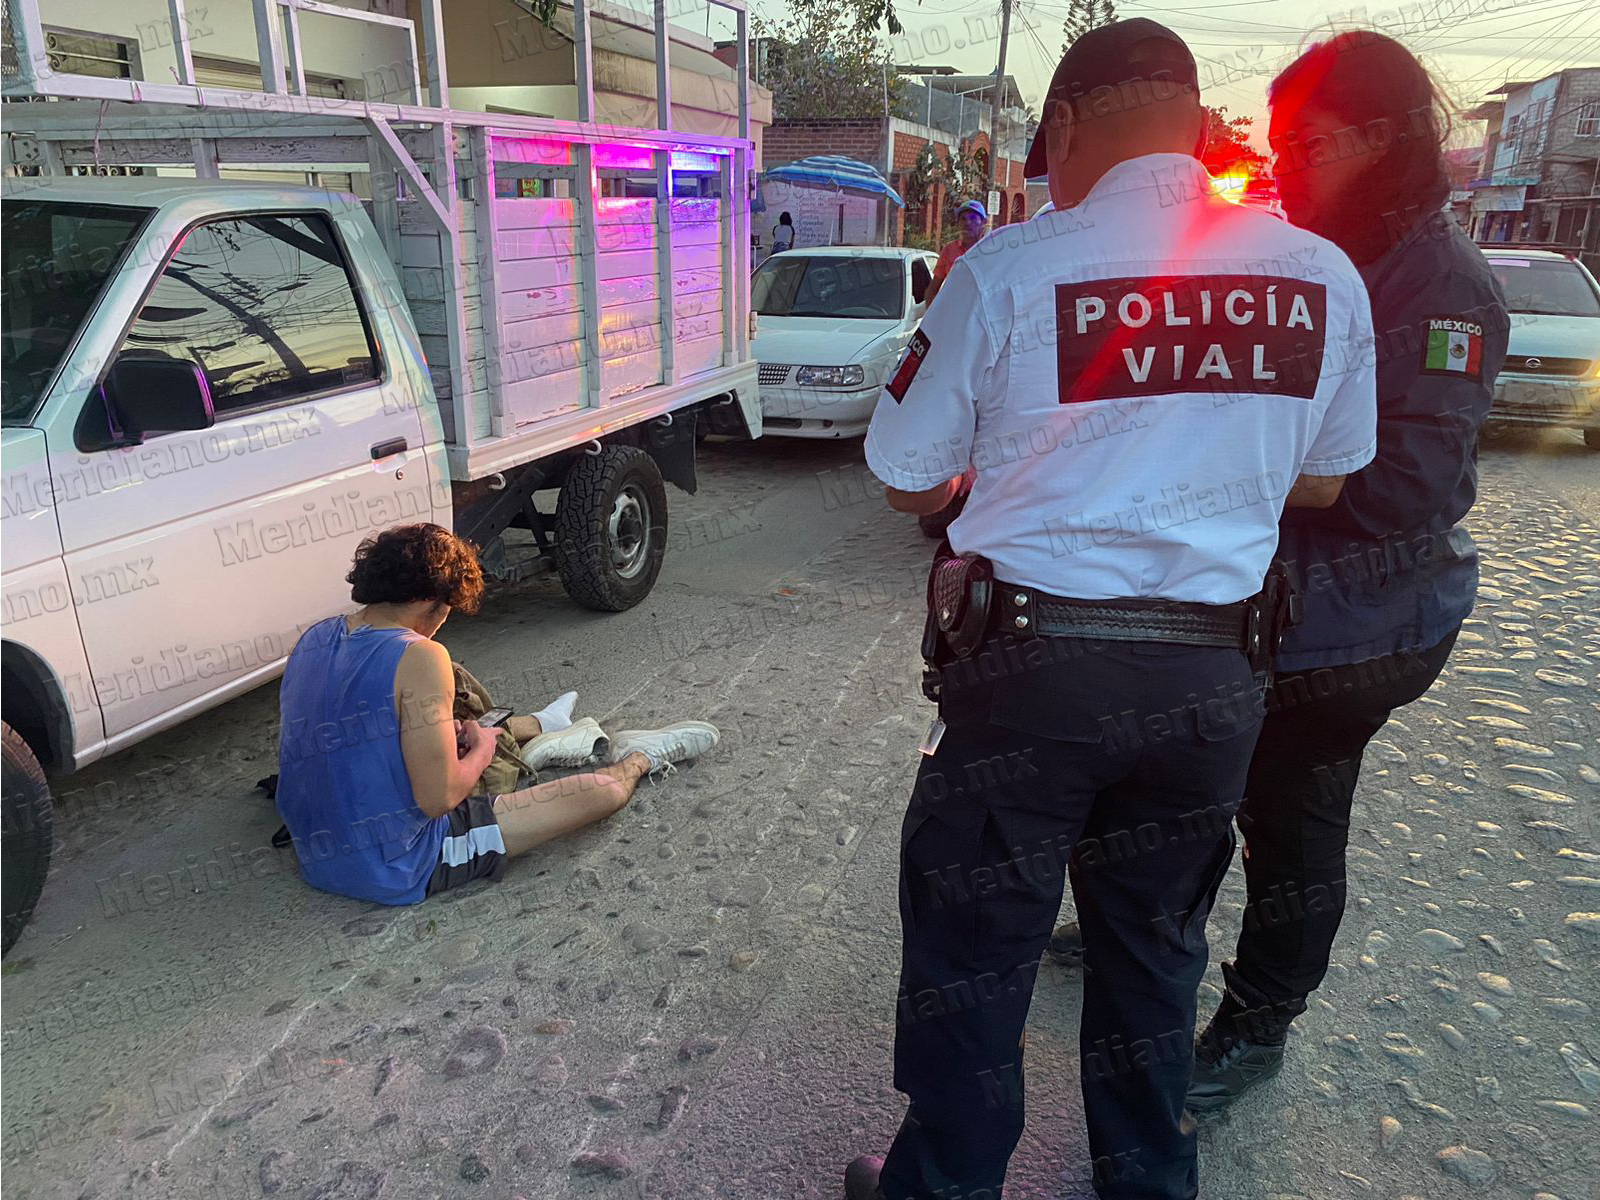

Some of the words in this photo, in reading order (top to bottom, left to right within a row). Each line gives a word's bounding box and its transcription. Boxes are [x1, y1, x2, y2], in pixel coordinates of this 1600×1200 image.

[1075, 285, 1314, 334] POLICÍA
[1430, 319, 1482, 336] MÉXICO
[1122, 344, 1276, 383] VIAL
